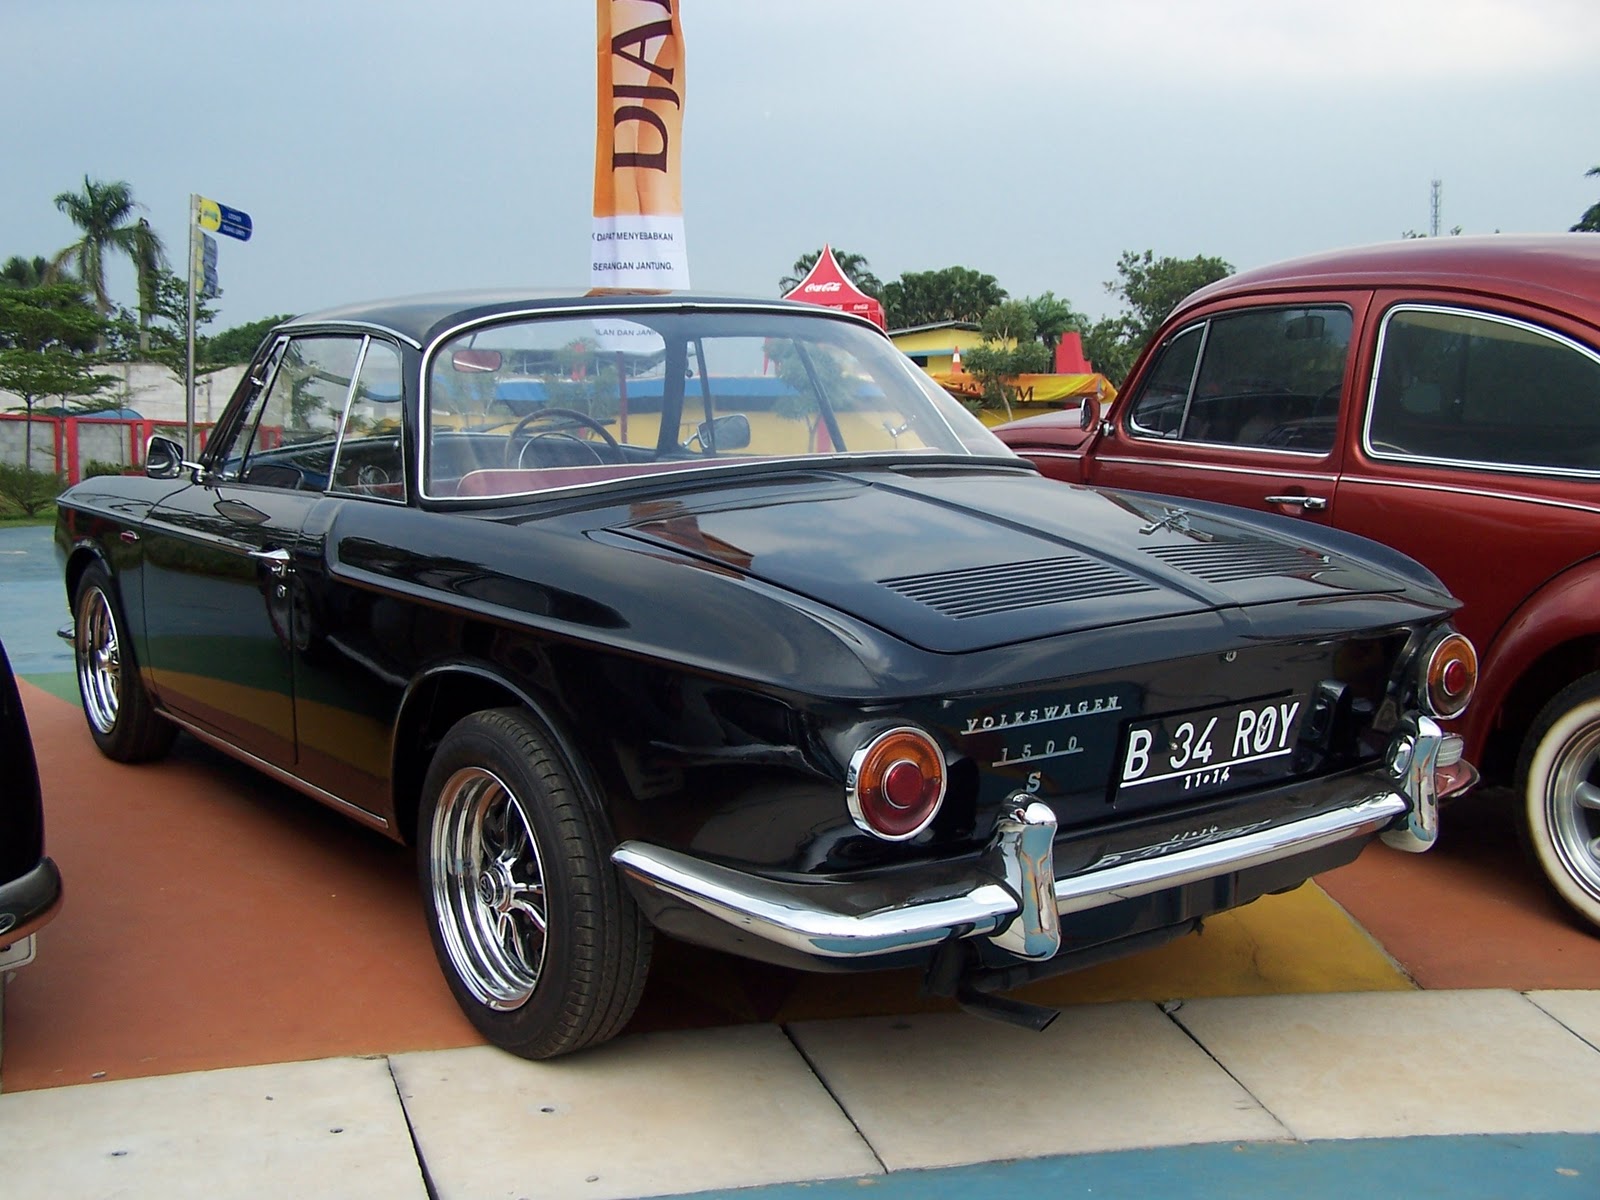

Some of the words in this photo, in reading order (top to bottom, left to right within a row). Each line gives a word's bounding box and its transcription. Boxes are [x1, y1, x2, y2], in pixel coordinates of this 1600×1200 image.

[612, 0, 680, 173] DJA
[616, 231, 674, 241] MENYEBABKAN
[592, 261, 634, 271] SERANGAN
[804, 282, 842, 293] Coca-Cola
[966, 696, 1118, 732] VOLKSWAGEN
[1001, 736, 1078, 762] 1500
[1123, 729, 1152, 781] B
[1170, 717, 1218, 769] 34
[1026, 771, 1041, 793] S
